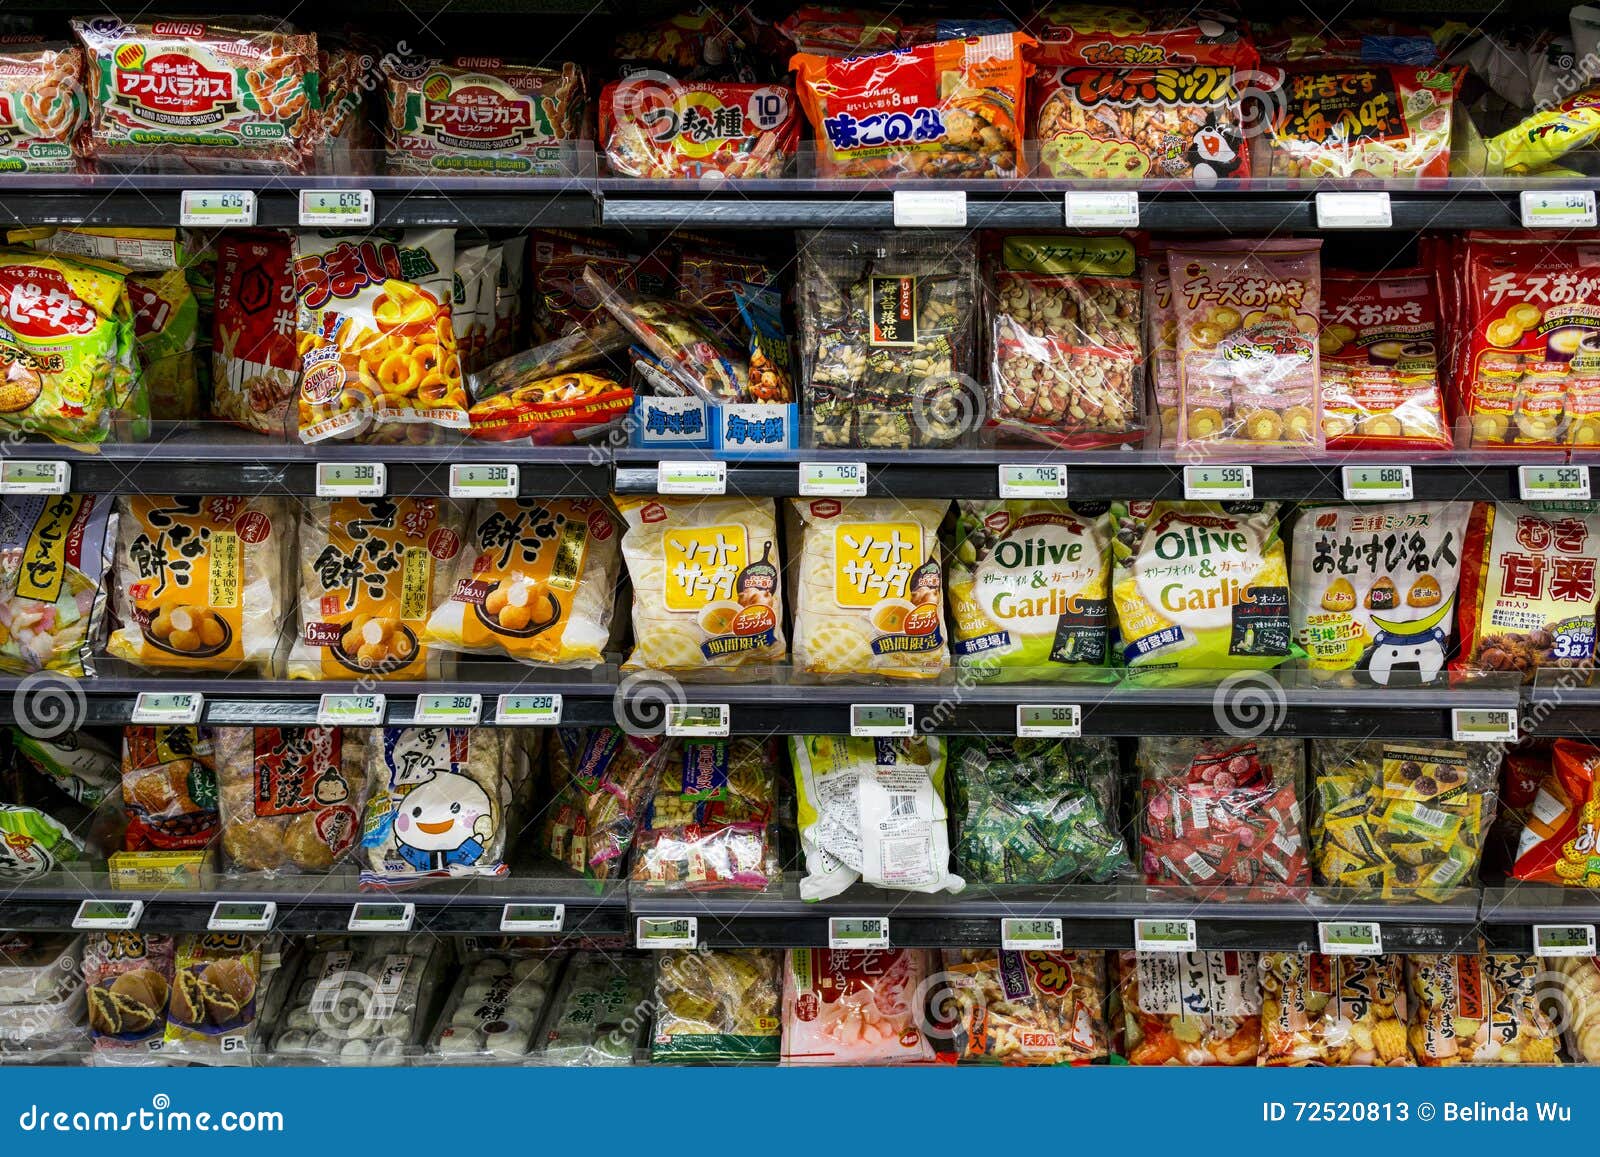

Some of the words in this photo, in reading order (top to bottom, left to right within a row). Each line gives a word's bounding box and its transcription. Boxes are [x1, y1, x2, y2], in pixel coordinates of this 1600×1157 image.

[154, 22, 204, 36] GINBIS
[116, 44, 145, 66] MINI
[457, 57, 501, 68] GINBIS
[151, 62, 200, 76] ギンビス
[121, 73, 228, 98] アスパラガス
[424, 80, 448, 101] MINI
[508, 78, 543, 89] GINBIS
[1293, 71, 1377, 99] 好きです
[154, 96, 199, 106] ビスケット
[755, 95, 780, 116] 10
[430, 104, 526, 125] アスパラガス
[643, 103, 745, 142] つまみ種
[133, 133, 165, 143] BLACK
[245, 125, 253, 136] 6
[254, 127, 283, 138] Packs
[458, 124, 498, 133] ビスケット
[824, 108, 946, 148] 味ごのみ
[32, 146, 41, 156] 6
[42, 147, 68, 156] Packs
[436, 159, 463, 169] BLACK
[1184, 276, 1305, 309] チーズおかき
[879, 279, 898, 341] 海苔落花
[1350, 513, 1432, 531] 三種ミックス
[477, 510, 524, 570] 餅
[1154, 526, 1248, 561] Olive
[1515, 515, 1589, 554] むき
[670, 533, 739, 566] ソフト
[842, 530, 913, 563] ソフト
[994, 540, 1084, 570] Olive
[1311, 530, 1458, 575] おむすび名人
[130, 532, 169, 597] 餅
[212, 535, 224, 604] 新しい美味しさ!
[222, 535, 237, 605] 国産もち米100%で
[1144, 565, 1196, 579] オリーブオイル
[1199, 558, 1218, 578] &
[313, 544, 364, 609] 餅
[672, 562, 739, 601] サラダ
[842, 559, 913, 598] サラダ
[1031, 570, 1049, 589] &
[1500, 552, 1597, 604] 甘栗
[991, 589, 1086, 620] Garlic
[1160, 580, 1259, 613] Garlic
[1495, 600, 1530, 609] 割れ入り
[306, 623, 341, 642] 6袋入り
[707, 634, 769, 653] 期間限定
[965, 634, 1007, 653] 新登場!
[1137, 628, 1184, 653] 新登場!
[1299, 622, 1363, 644] ご当地紹介
[878, 634, 938, 654] 期間限定
[1314, 643, 1347, 656] 実施中!
[1553, 633, 1572, 657] 3
[1570, 643, 1592, 657] 袋入
